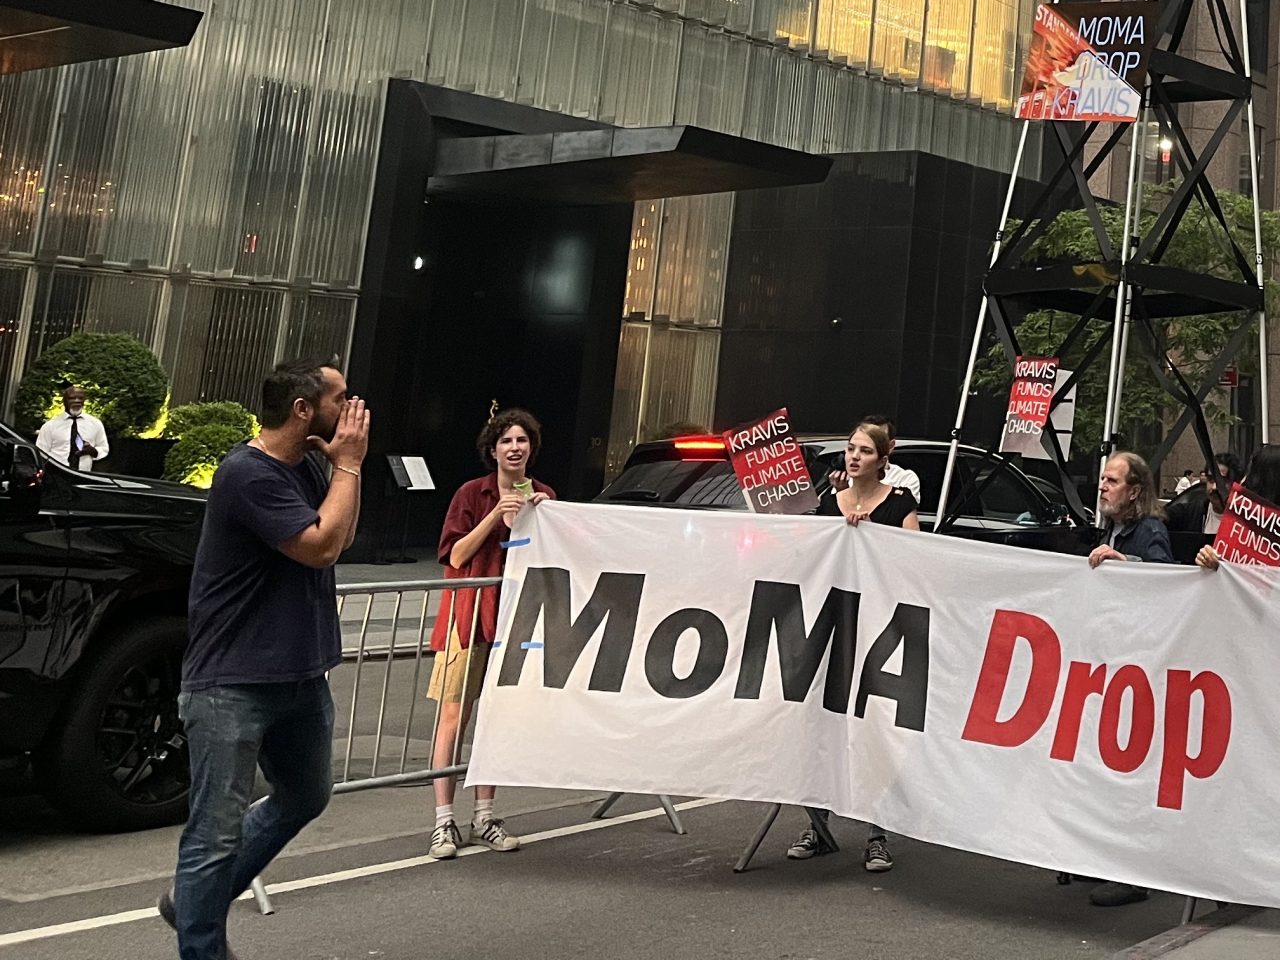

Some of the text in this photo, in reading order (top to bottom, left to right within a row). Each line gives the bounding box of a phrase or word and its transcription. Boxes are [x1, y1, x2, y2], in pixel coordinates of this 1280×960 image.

[1077, 15, 1145, 46] MOMA
[1015, 361, 1056, 379] KRAVIS
[1016, 381, 1052, 398] FUNDS
[1009, 400, 1048, 417] CLIMATE
[728, 415, 790, 453] KRAVIS
[1008, 419, 1043, 435] CHAOS
[745, 437, 797, 469] FUNDS
[743, 455, 804, 491] CLIMATE
[757, 475, 810, 507] CHAOS
[497, 566, 931, 733] MoMA
[961, 608, 1233, 811] Drop
